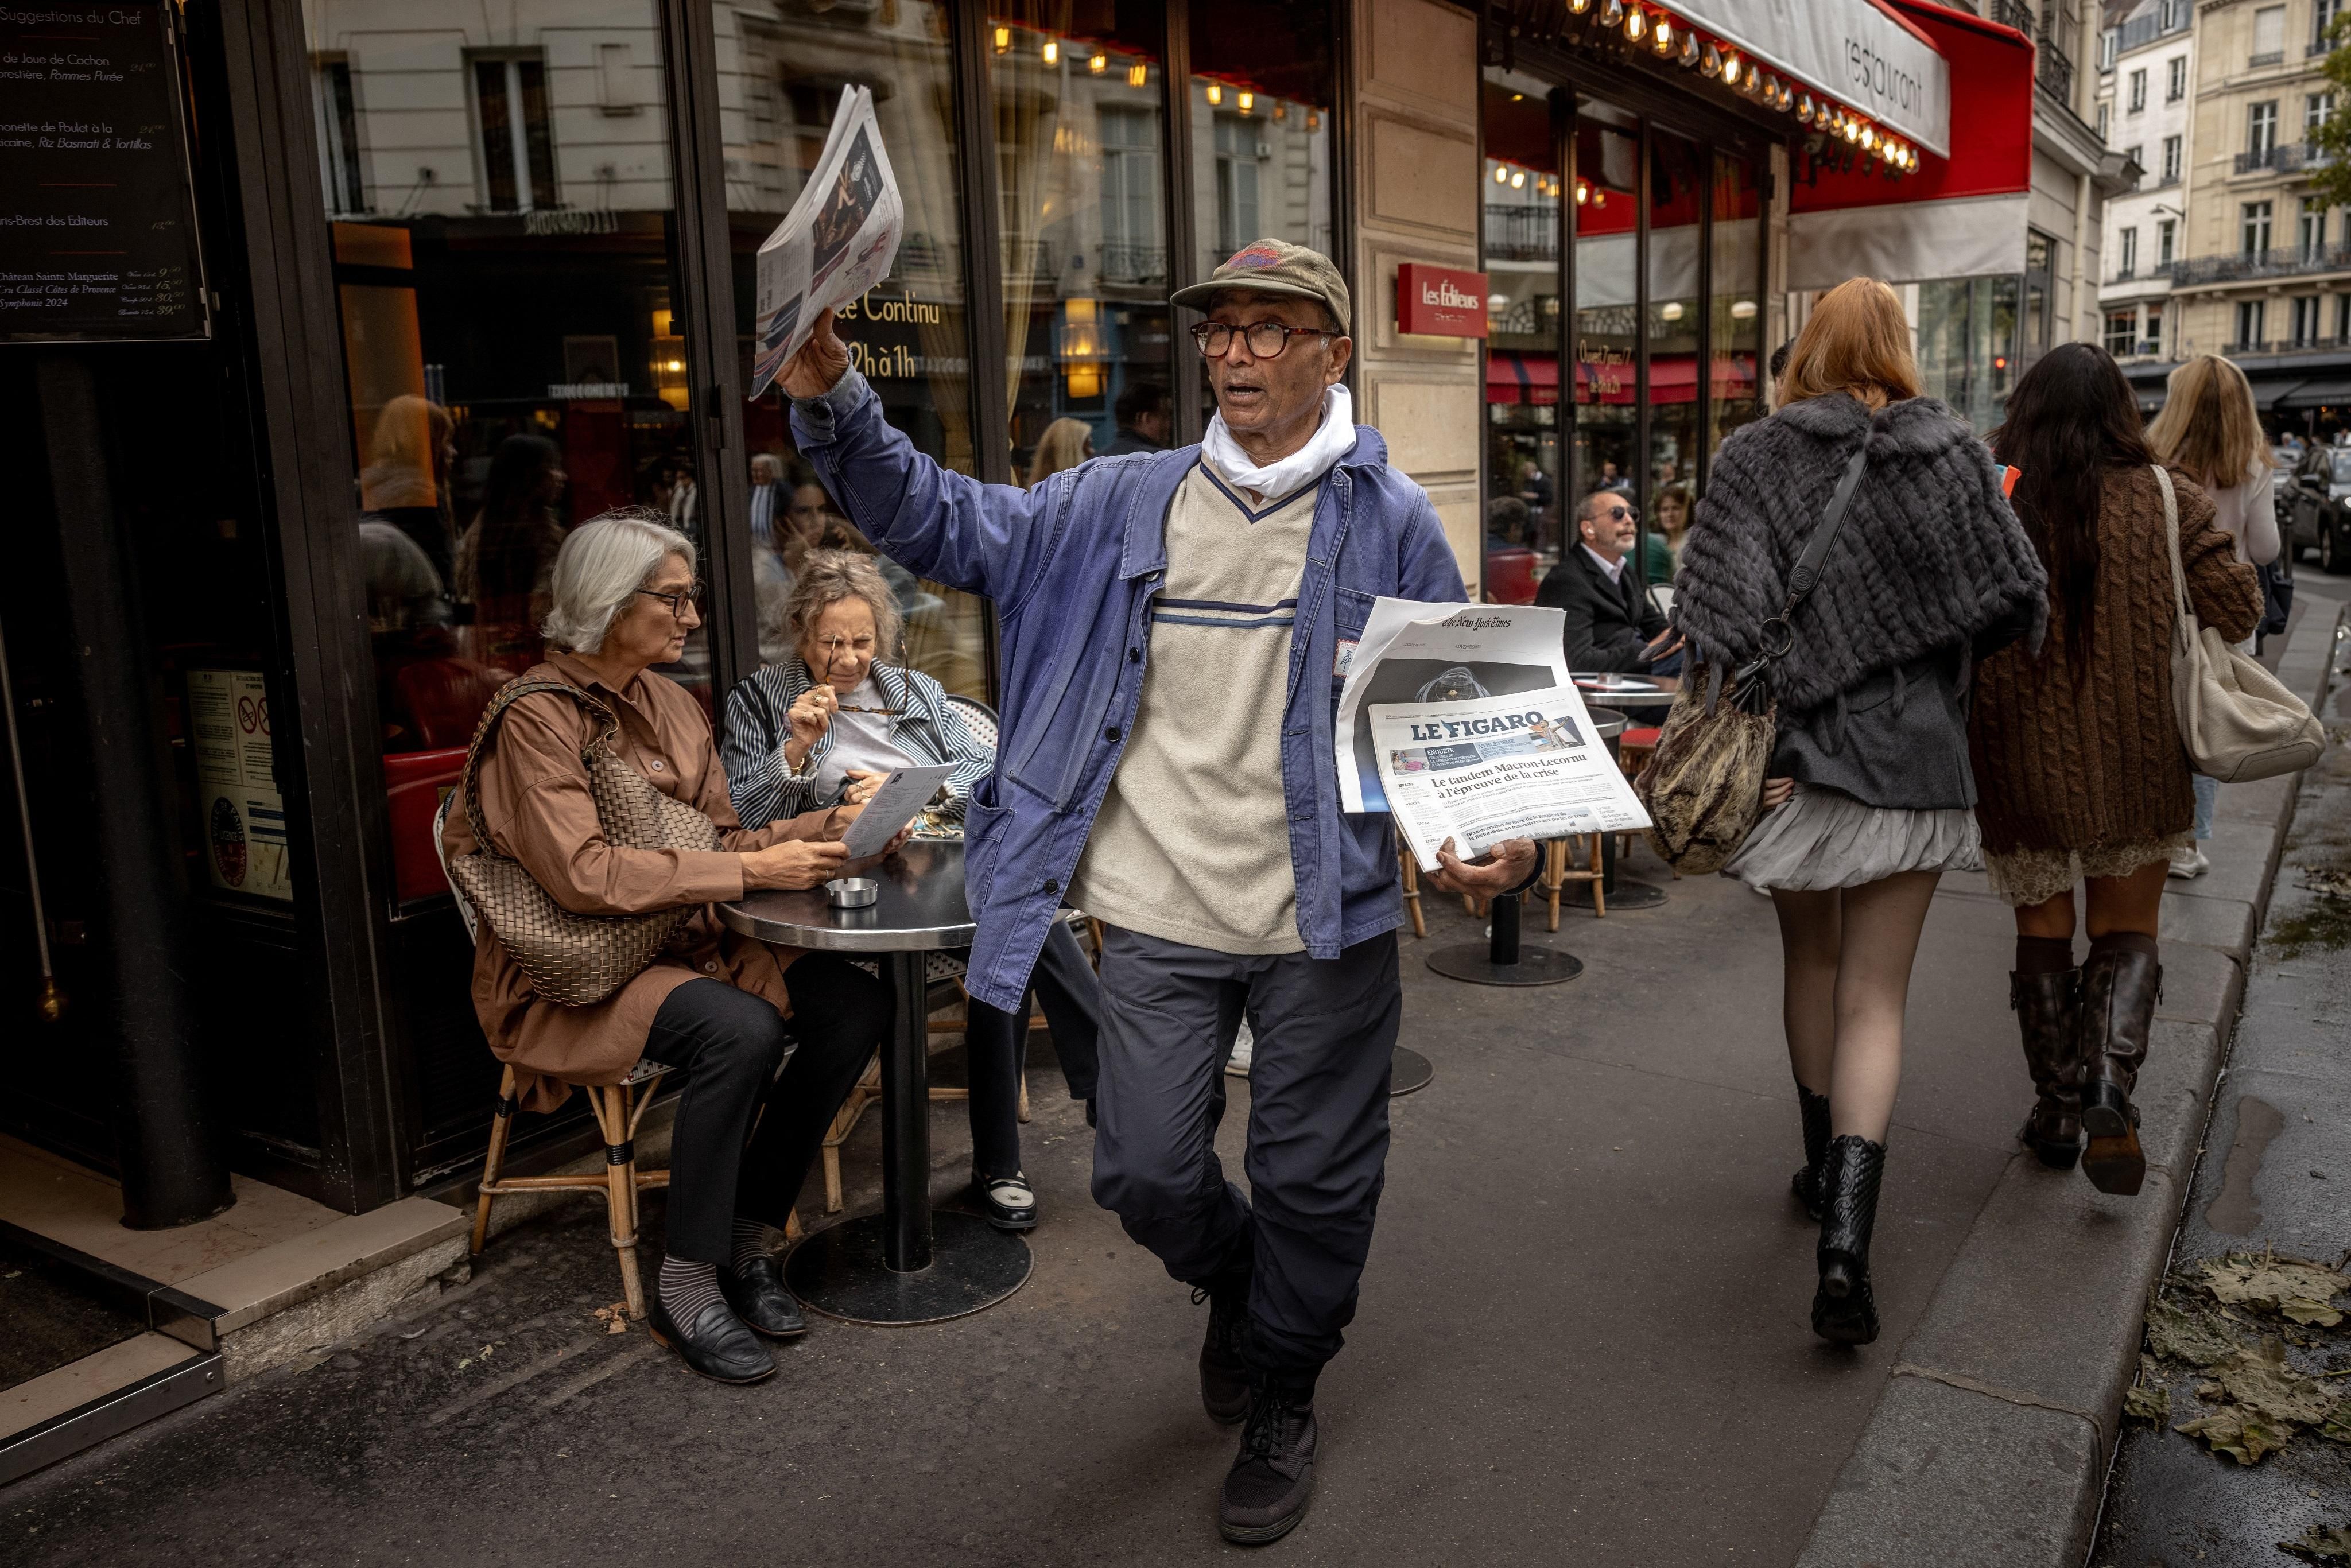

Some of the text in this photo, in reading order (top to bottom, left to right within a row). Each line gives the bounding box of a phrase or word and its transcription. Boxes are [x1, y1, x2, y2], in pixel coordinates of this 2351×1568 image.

[0, 7, 142, 25] Suggestions du Chef
[3, 52, 109, 65] de Joue de Cochon
[49, 69, 91, 81] Pommes
[94, 71, 124, 82] Purée
[1845, 37, 1922, 119] restaurant
[41, 121, 56, 133] de
[59, 122, 88, 133] Poulet
[91, 123, 99, 133] à
[102, 122, 113, 133] la
[0, 137, 152, 149] icaine, Riz Basmati & Tortillas
[0, 215, 109, 227] ris-Brest des Editeurs
[36, 272, 65, 281] Sainte
[67, 272, 119, 282] Marguerite
[0, 285, 117, 294] Cru Classé Côtes de Provence
[1422, 281, 1440, 305] Les
[0, 298, 68, 310] Symphonie 2024
[864, 283, 940, 324] Continu
[879, 347, 892, 377] à
[893, 345, 915, 377] 1h
[1441, 616, 1511, 631] The New York Times
[1410, 723, 1443, 740] LE
[1446, 711, 1544, 738] FIGARO
[1427, 747, 1455, 756] ENQUÊTE
[1431, 778, 1446, 788] Le
[1448, 768, 1494, 785] tandem
[1494, 754, 1587, 774] Macron-Lecornu
[1437, 790, 1446, 799] à
[1504, 773, 1519, 782] de
[1519, 770, 1532, 779] la
[1533, 767, 1560, 778] crise
[1466, 823, 1504, 837] Démonstration
[1475, 828, 1504, 840] Biélorussie,
